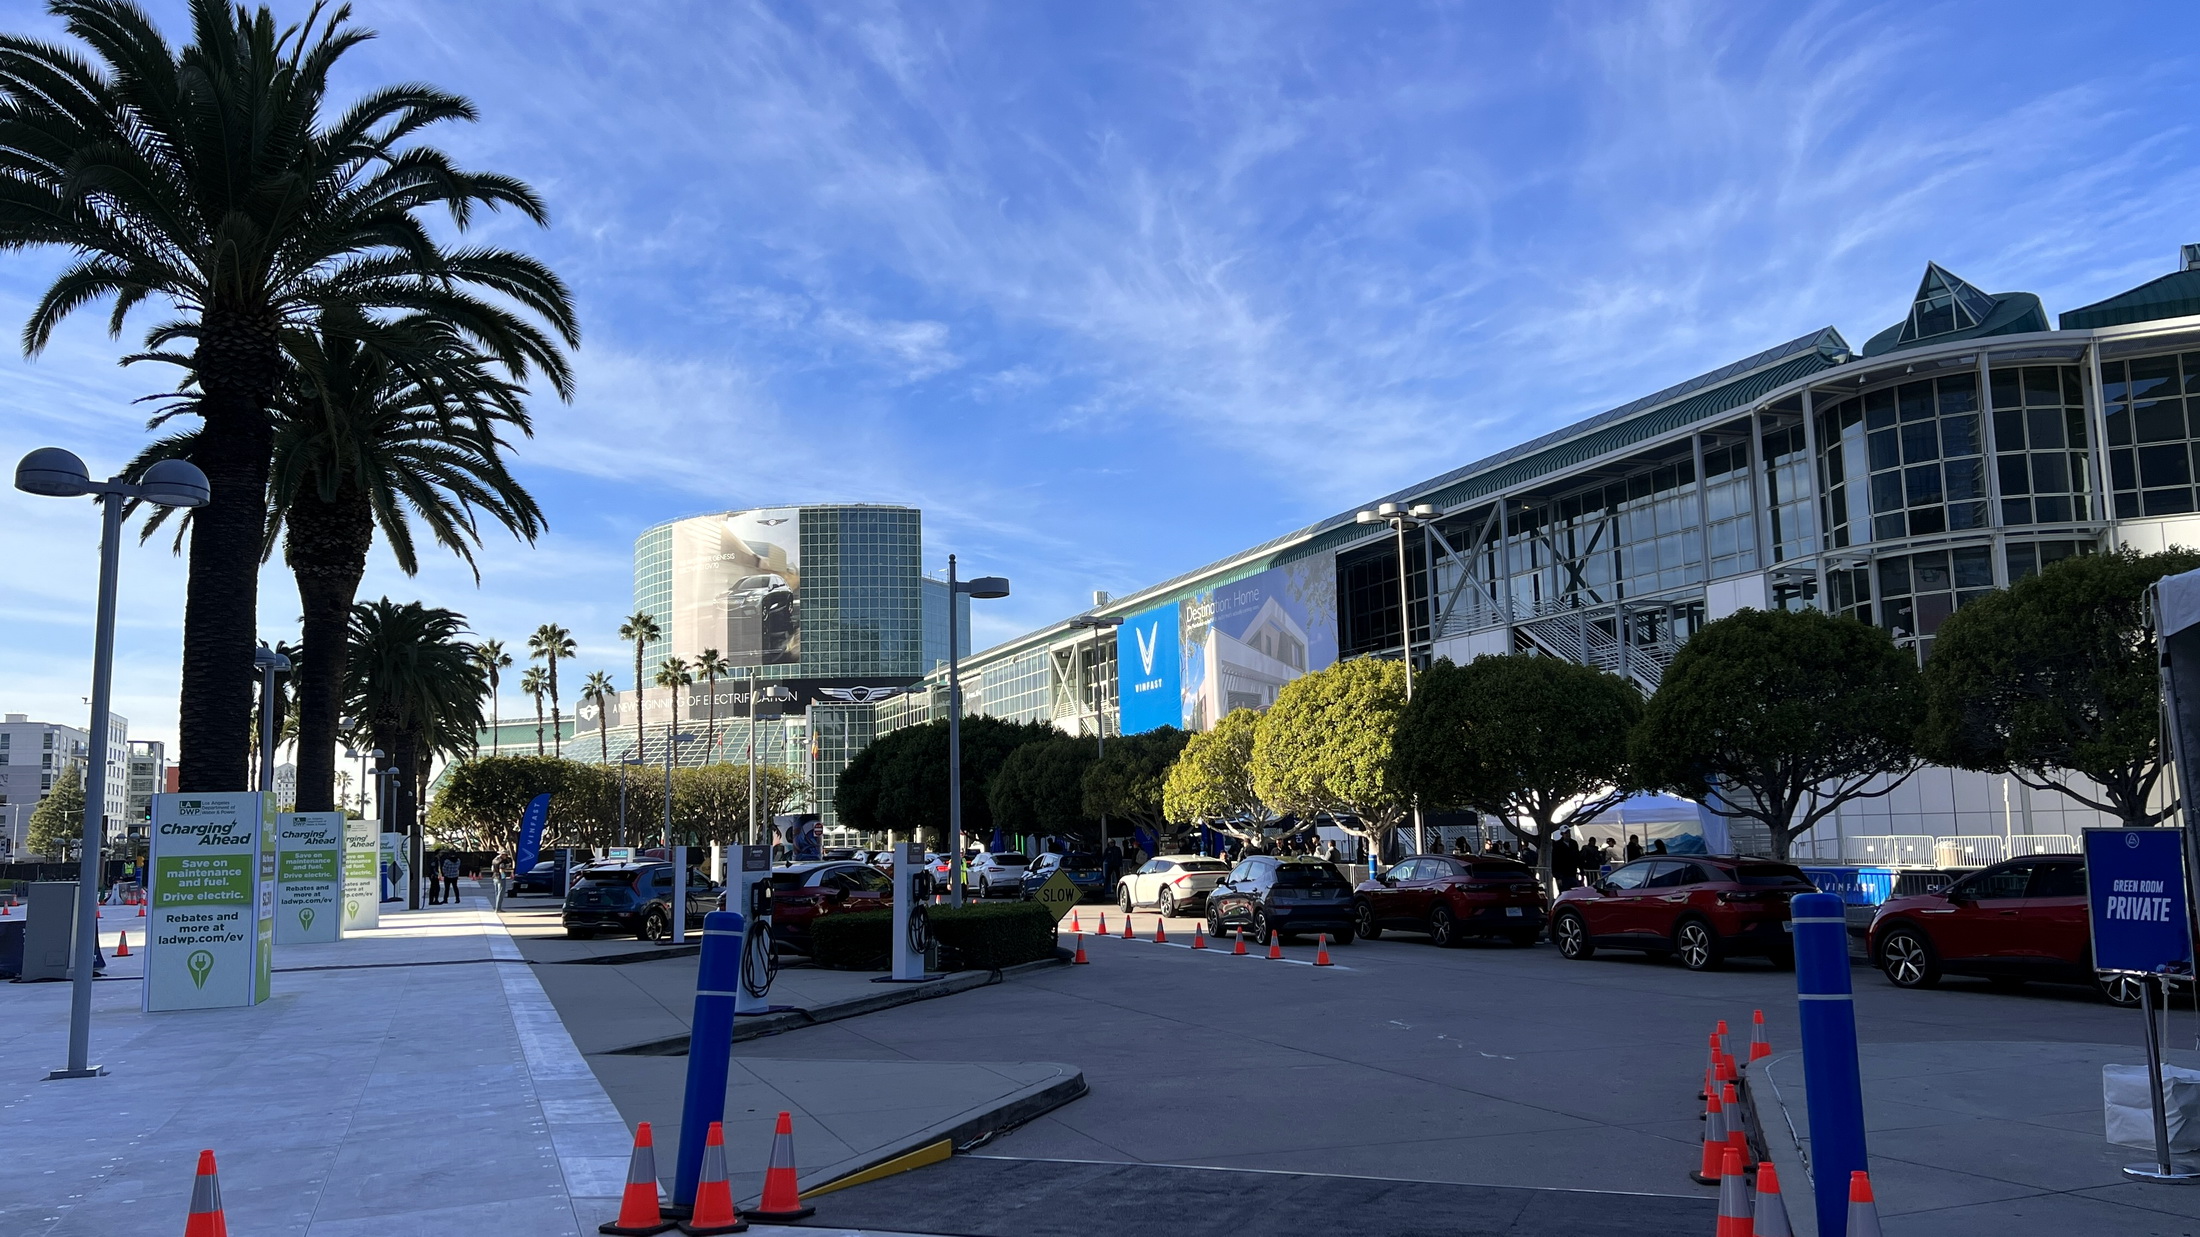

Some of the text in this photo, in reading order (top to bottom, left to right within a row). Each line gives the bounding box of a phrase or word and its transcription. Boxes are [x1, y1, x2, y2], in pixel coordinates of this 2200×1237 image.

[1233, 588, 1260, 607] Home
[1135, 678, 1162, 693] VINFAST
[612, 690, 798, 714] A NEW EGINNIG OF EECTRIFAN
[160, 822, 233, 836] Charging
[527, 802, 540, 845] VINFAST
[198, 833, 251, 846] Ahead
[282, 830, 325, 839] Charging
[346, 834, 366, 843] rging
[304, 837, 336, 845] Ahead
[182, 860, 210, 868] Save
[167, 868, 241, 878] maintenance
[204, 878, 229, 886] fuel.
[1824, 882, 1876, 893] VINFAST
[2113, 879, 2164, 893] GREEN ROOM
[163, 891, 244, 901] Drive electric.
[281, 897, 333, 905] ladwp.com/ev
[1043, 888, 1074, 903] SLOW
[2106, 896, 2172, 922] PRIVATE
[166, 912, 238, 923] Rebates and
[179, 923, 225, 933] more at
[158, 932, 244, 945] ladwp.com/ev
